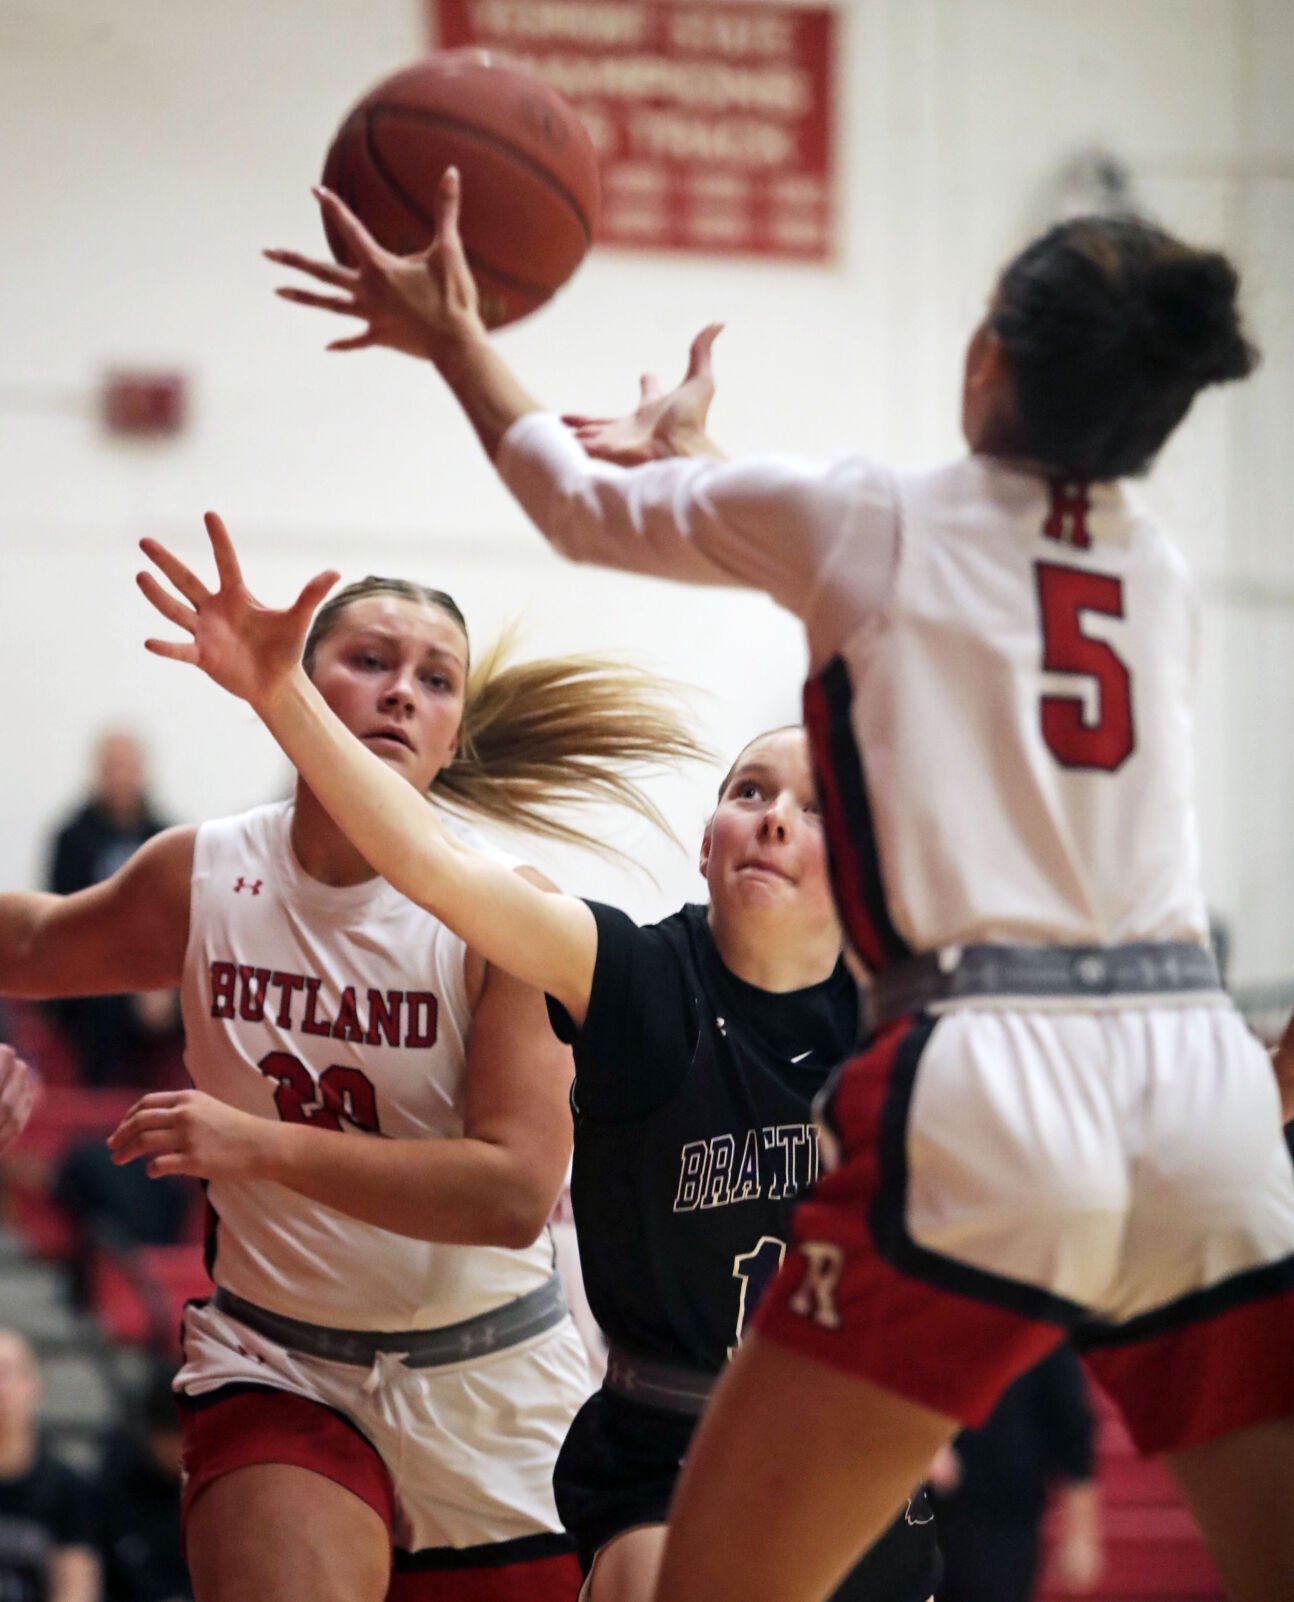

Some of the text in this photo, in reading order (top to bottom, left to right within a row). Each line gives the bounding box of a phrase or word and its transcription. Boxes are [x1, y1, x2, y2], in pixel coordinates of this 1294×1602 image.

[1034, 559, 1136, 770] 5
[210, 961, 439, 1048] RUTLAND
[789, 1242, 843, 1328] R
